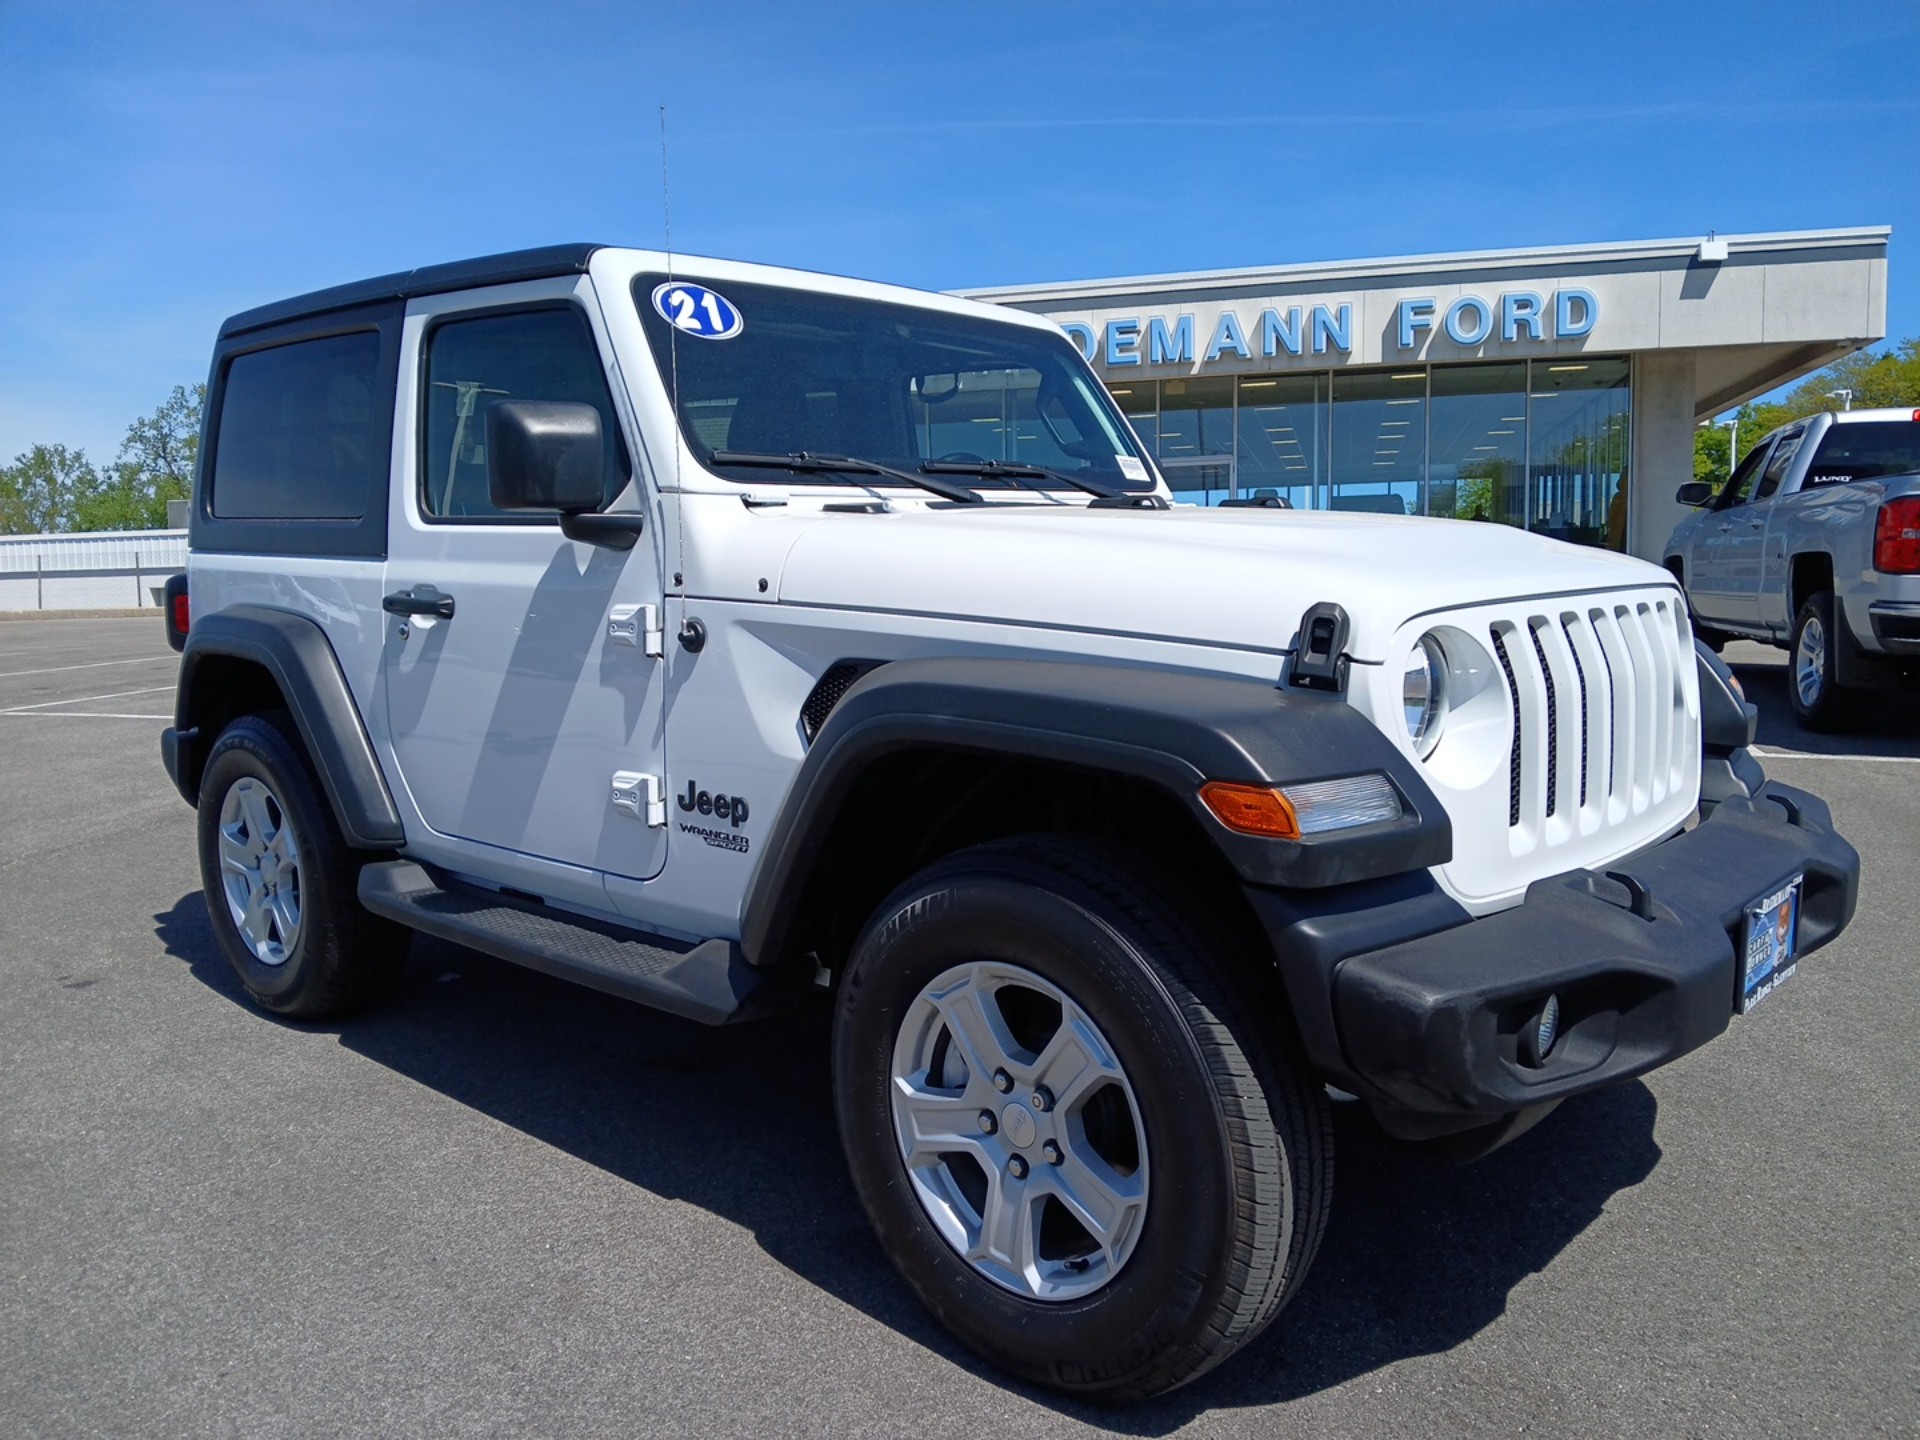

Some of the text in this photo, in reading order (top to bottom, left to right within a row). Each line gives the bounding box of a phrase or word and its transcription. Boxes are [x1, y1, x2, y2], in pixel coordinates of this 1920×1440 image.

[668, 289, 724, 332] 21
[1398, 287, 1600, 348] FORD
[1814, 475, 1850, 483] LUND
[677, 779, 749, 828] Jeep
[679, 822, 749, 845] WRANGLER
[704, 836, 749, 853] SPORT
